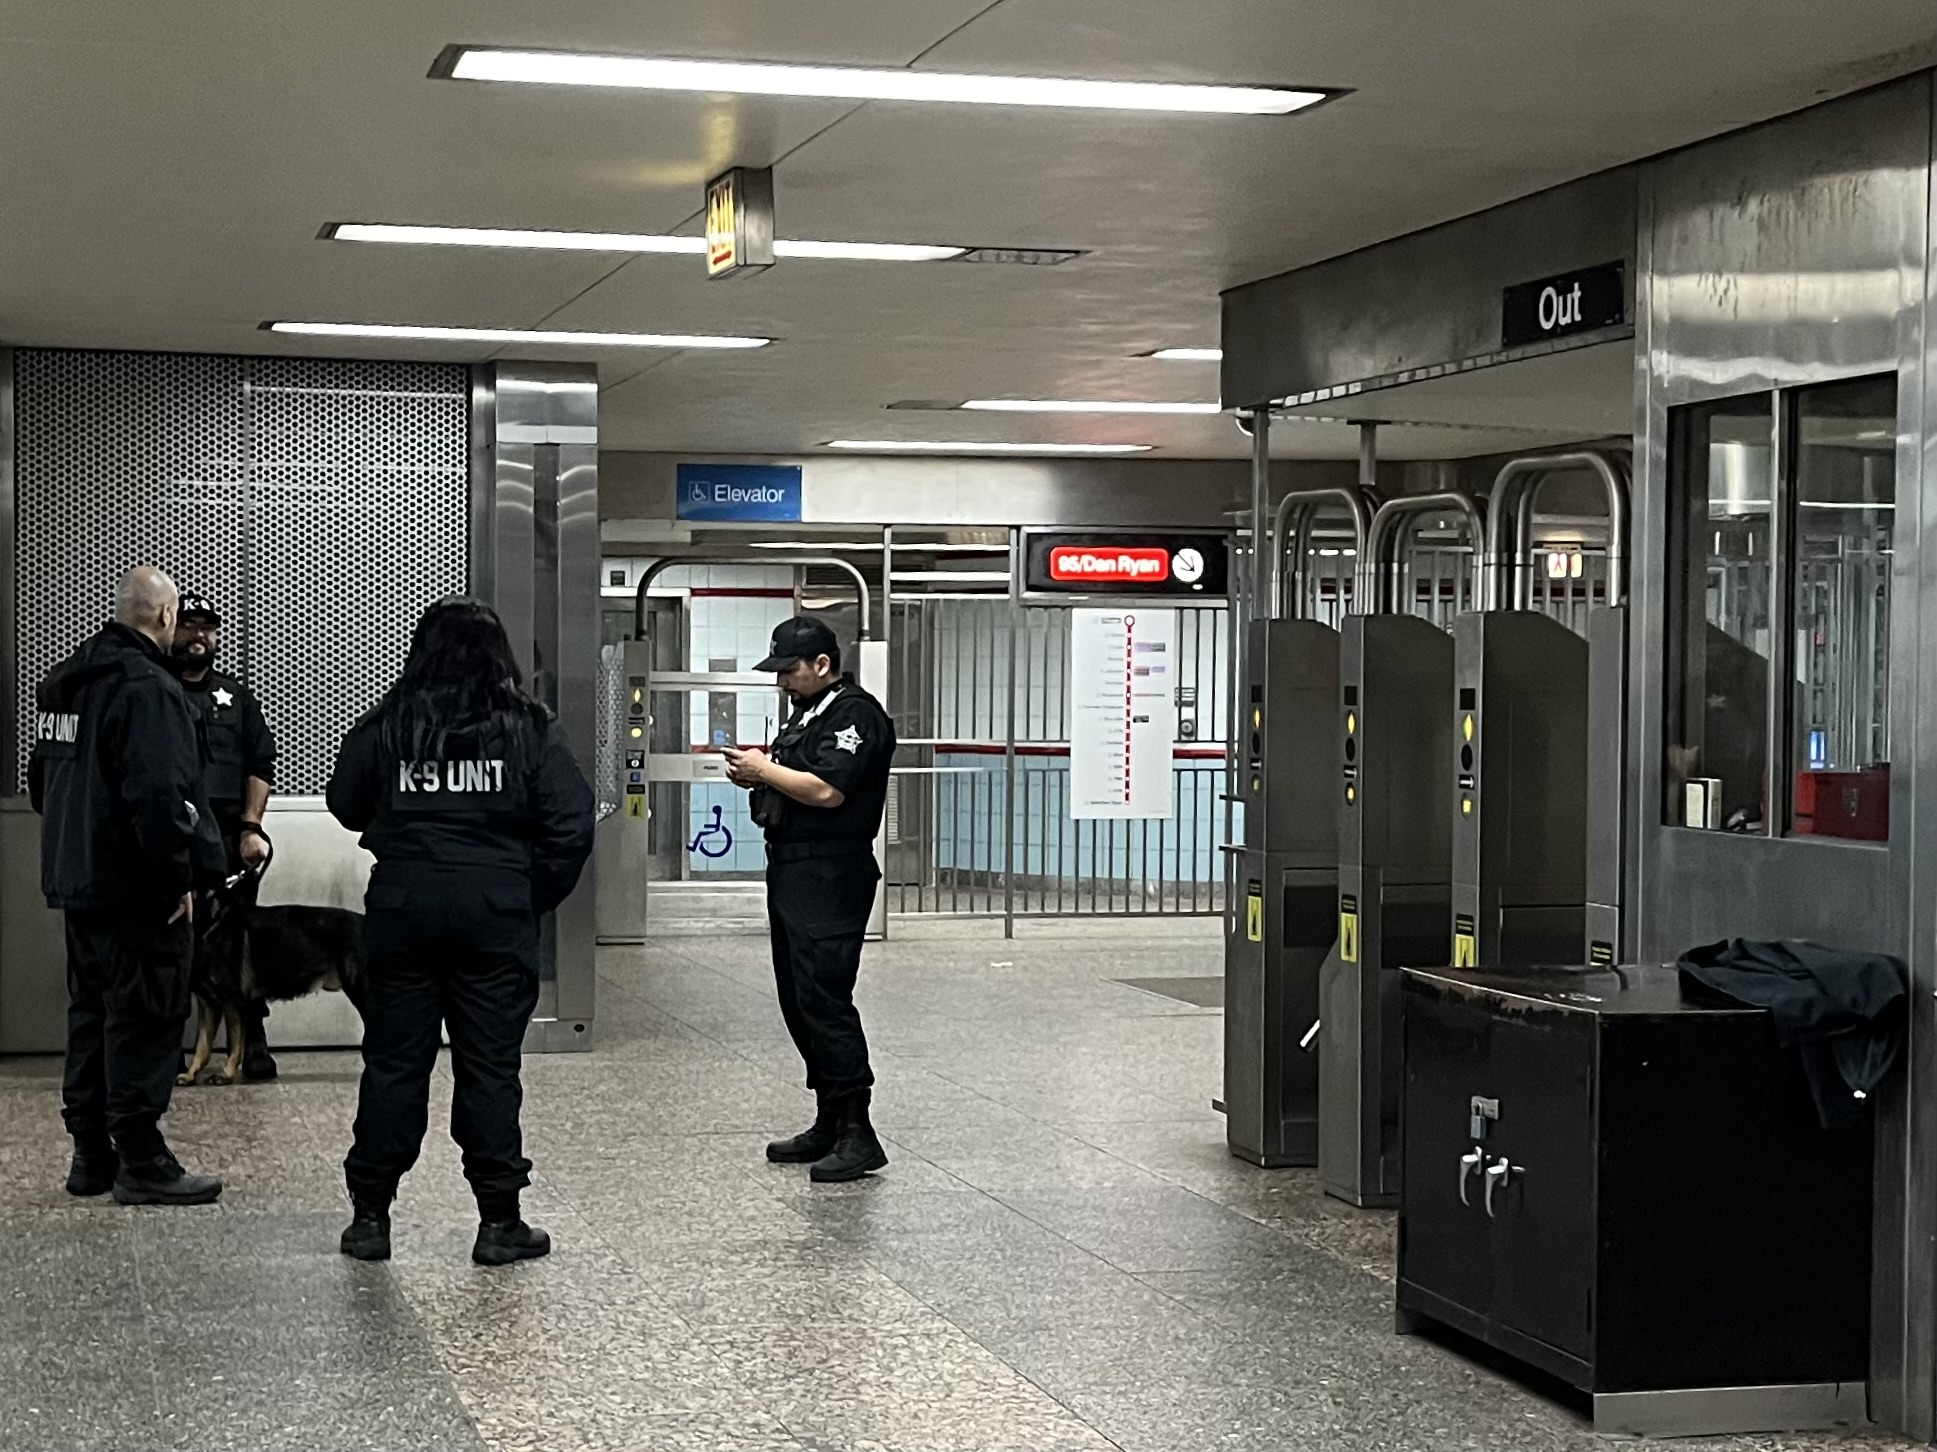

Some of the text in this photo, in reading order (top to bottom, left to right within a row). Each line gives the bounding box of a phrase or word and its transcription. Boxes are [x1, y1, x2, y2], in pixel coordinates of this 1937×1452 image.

[1539, 281, 1582, 330] Out
[714, 484, 785, 503] Elevator
[1058, 555, 1160, 577] 95/Dan Ryan
[38, 711, 79, 743] K-9 UNIT
[399, 760, 503, 792] K-9 UNIT
